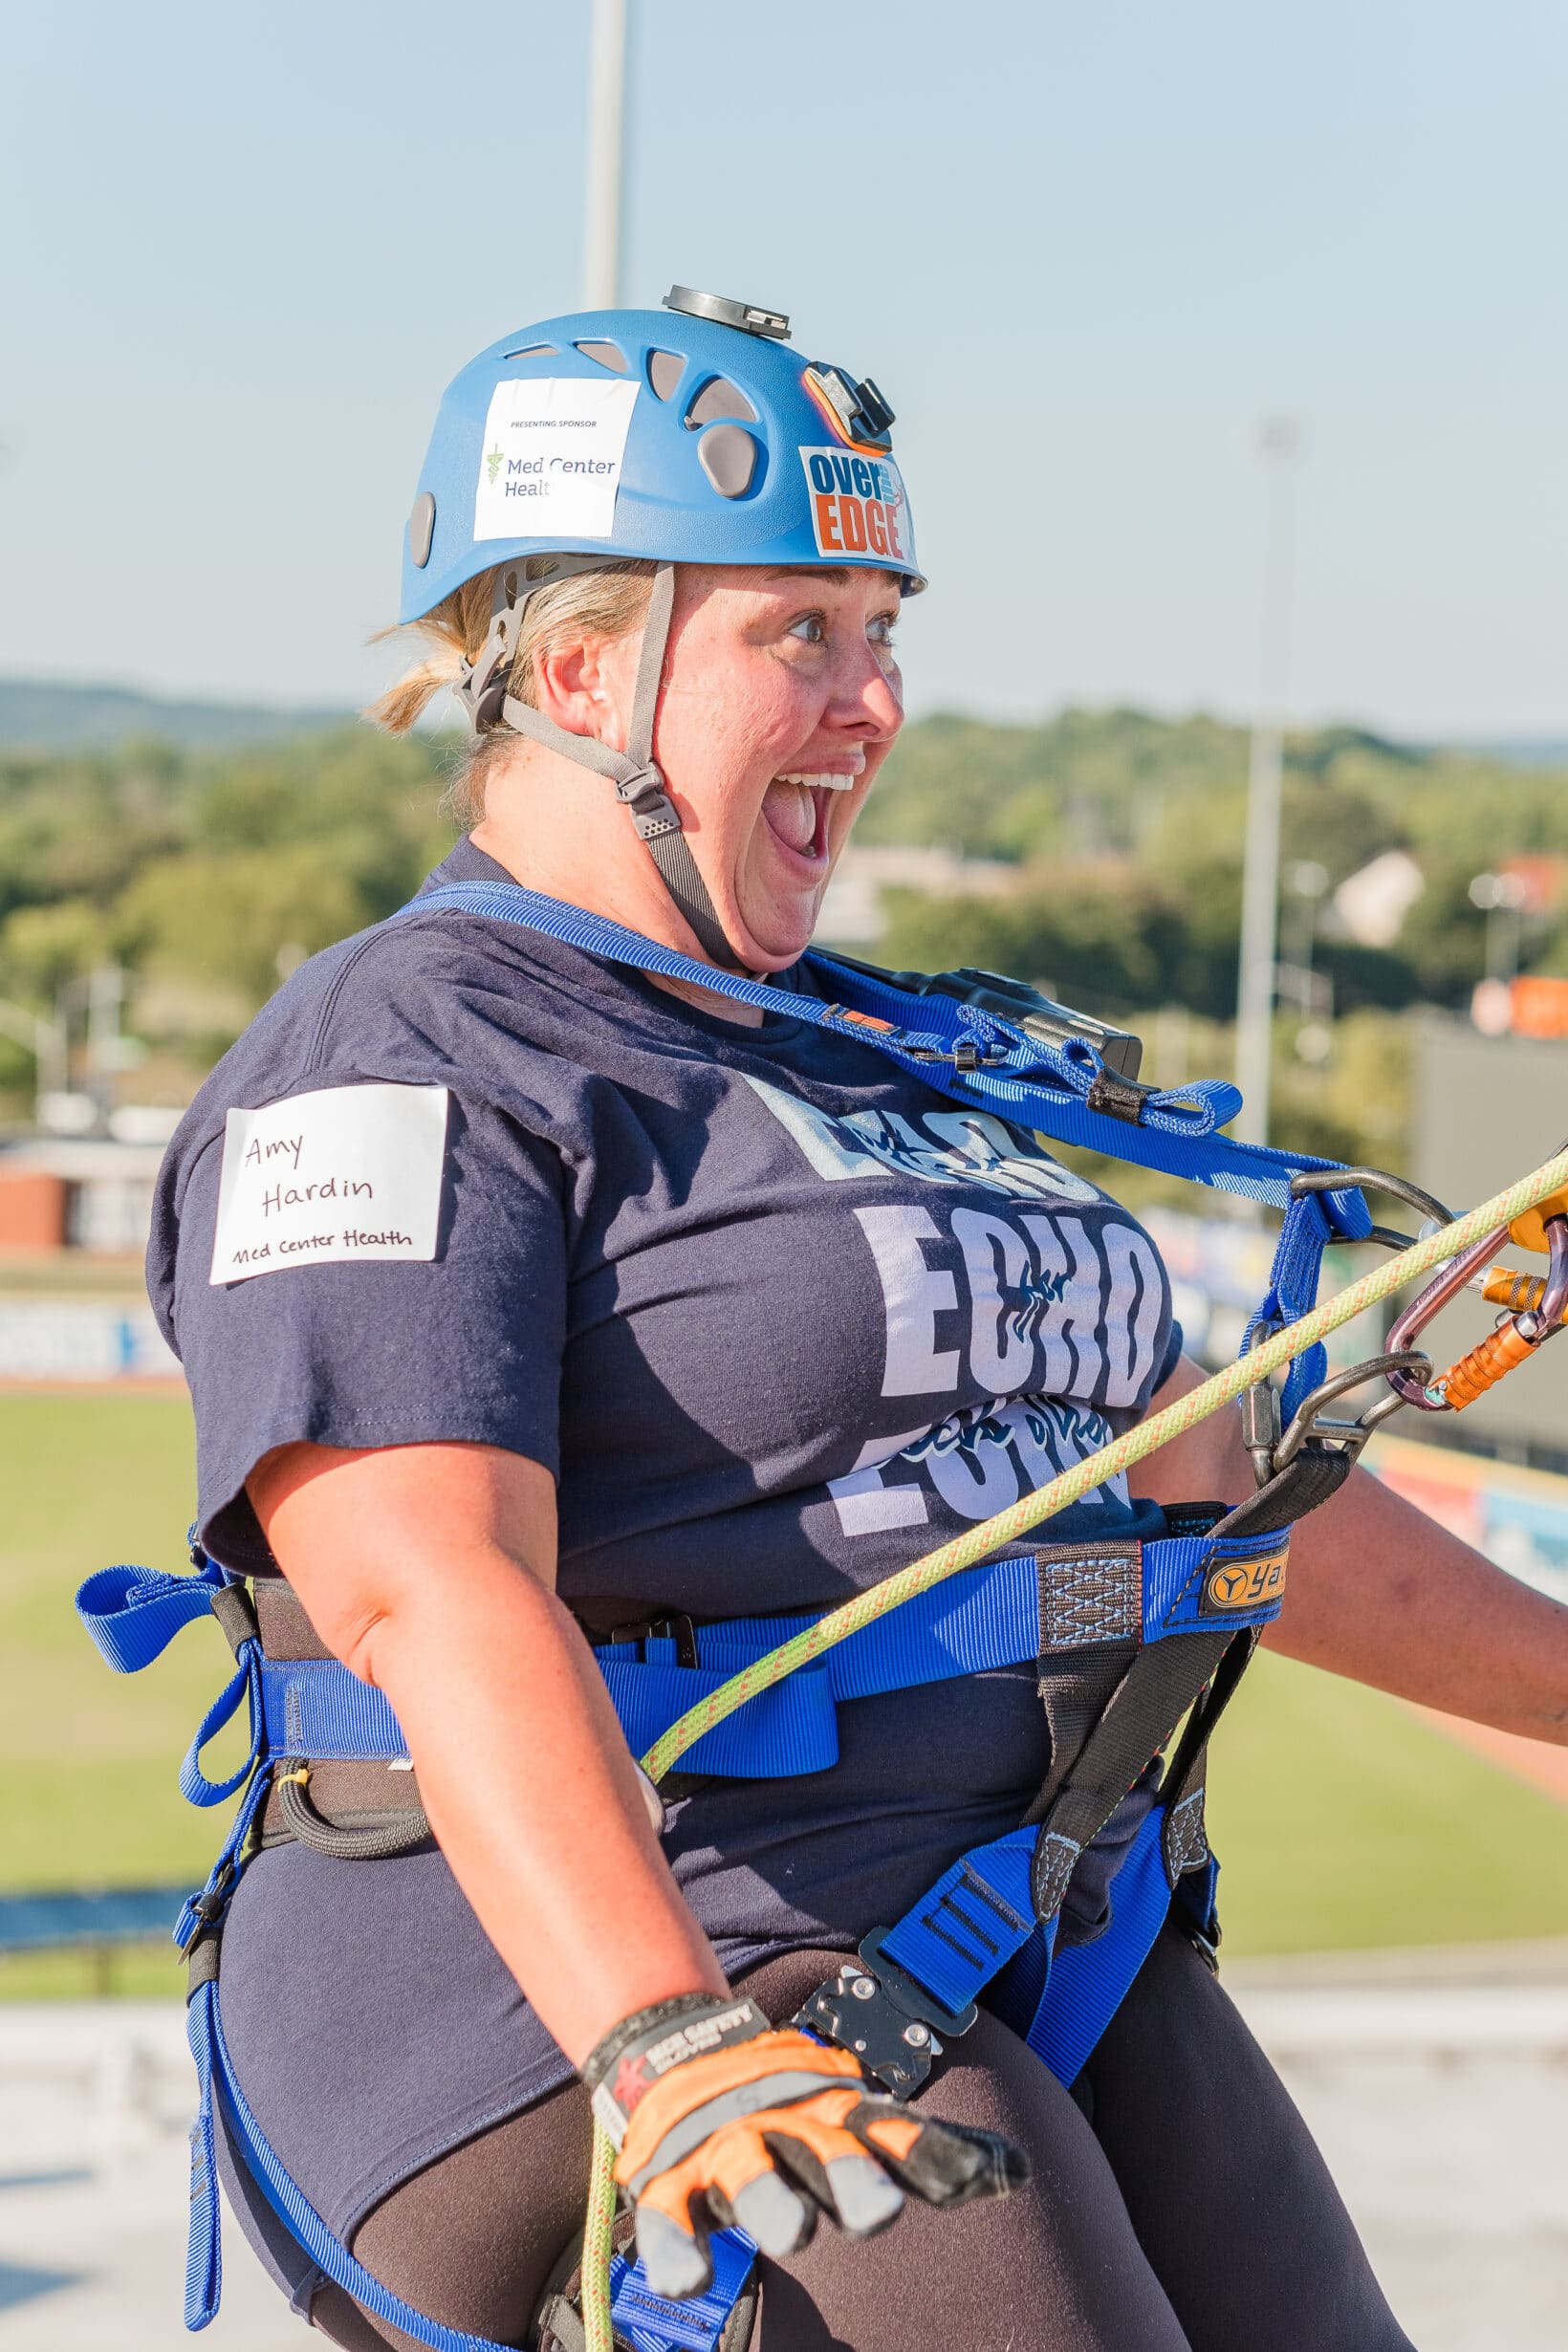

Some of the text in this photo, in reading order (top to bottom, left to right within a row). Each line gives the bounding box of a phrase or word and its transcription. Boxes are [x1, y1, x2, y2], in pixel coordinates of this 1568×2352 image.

[511, 420, 597, 428] PRESENTING SPONSOR
[508, 457, 544, 474] Med
[505, 480, 551, 497] Healt
[816, 494, 904, 560] EDGE
[245, 1135, 303, 1170] Amy
[262, 1177, 373, 1217] Hardin
[232, 1244, 271, 1264] Med
[343, 1230, 413, 1248] Health
[853, 1206, 1163, 1408] ECHO
